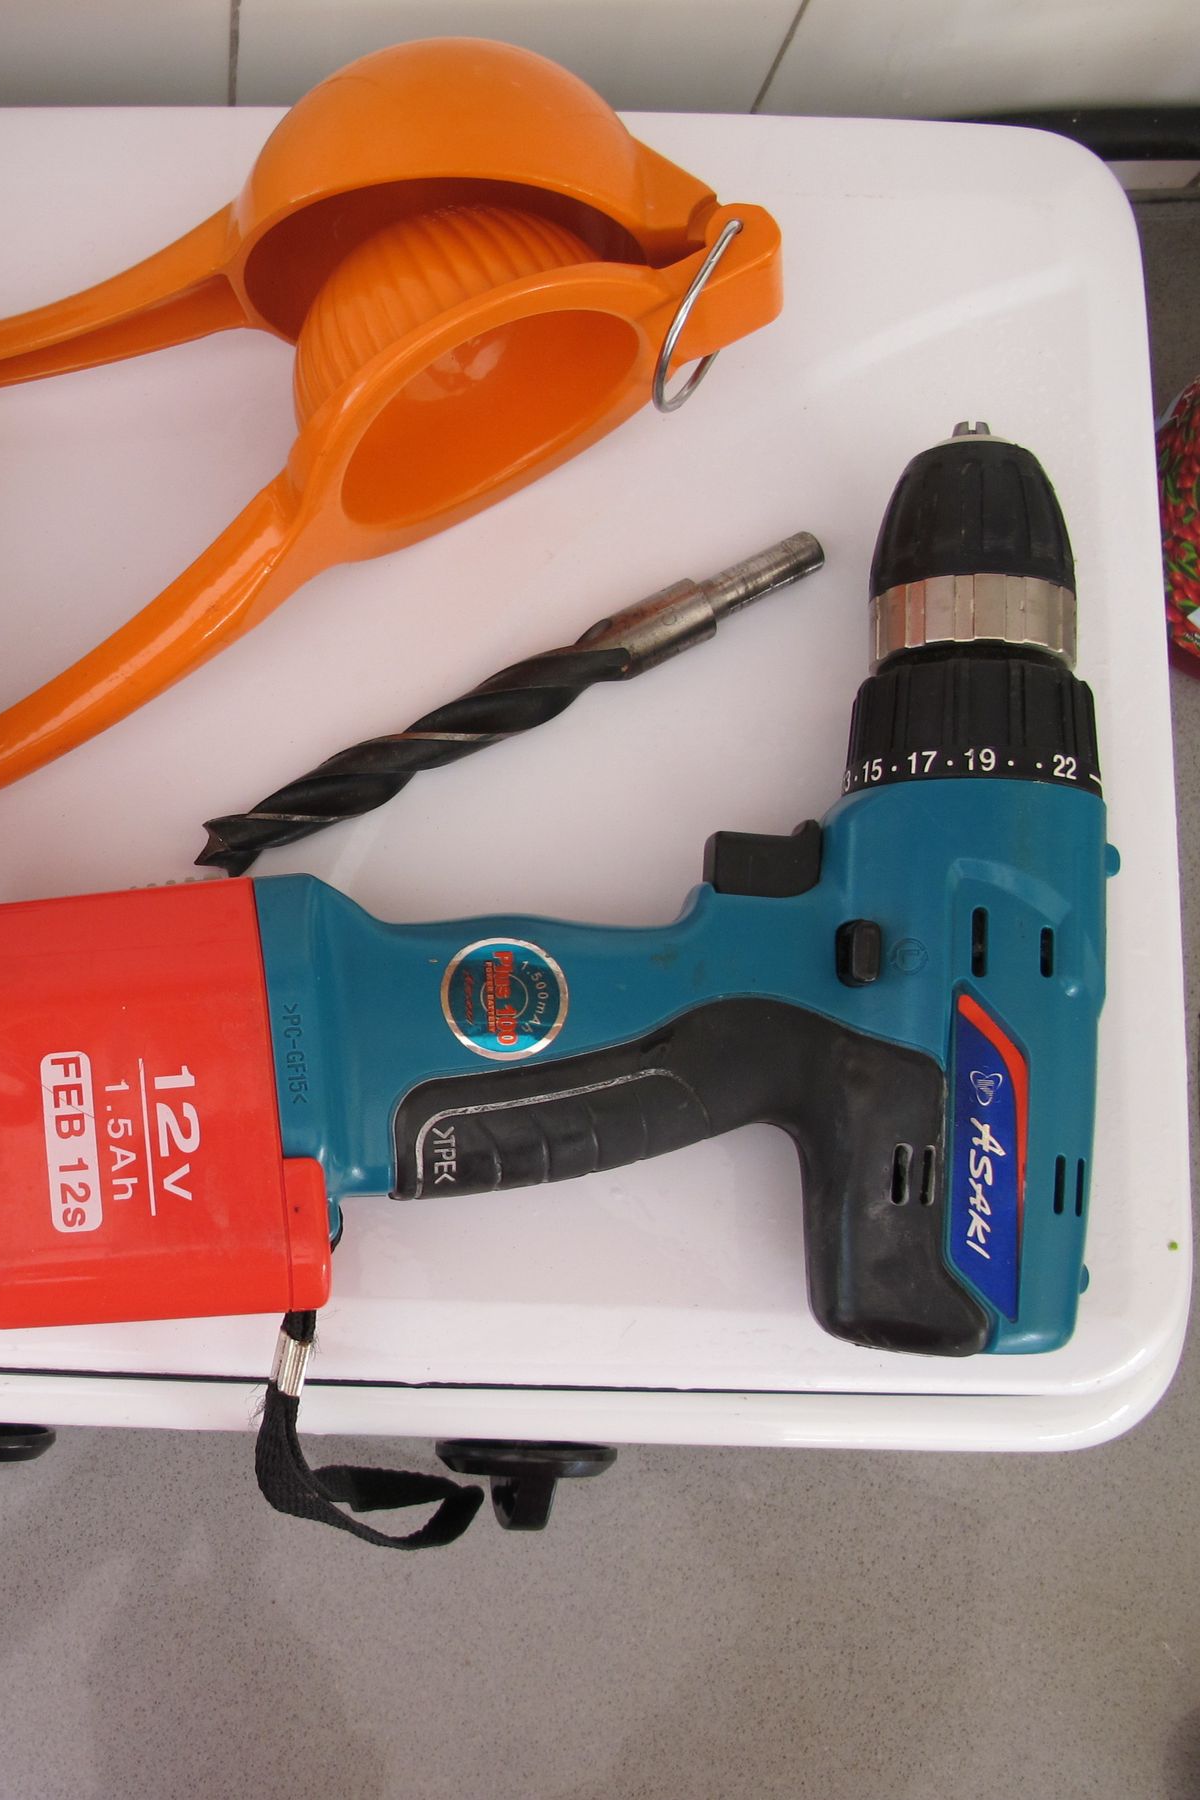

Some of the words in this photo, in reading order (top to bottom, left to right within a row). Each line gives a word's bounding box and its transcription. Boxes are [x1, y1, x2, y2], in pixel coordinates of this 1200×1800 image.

[862, 758, 883, 783] 15
[907, 750, 937, 775] 17
[963, 748, 997, 772] 19
[1052, 754, 1078, 780] 22
[493, 952, 512, 998] Plus
[496, 1005, 518, 1045] 100
[49, 1056, 86, 1140] FEB
[104, 1080, 139, 1201] 1.5Ah
[966, 1117, 1006, 1260] ASAKI
